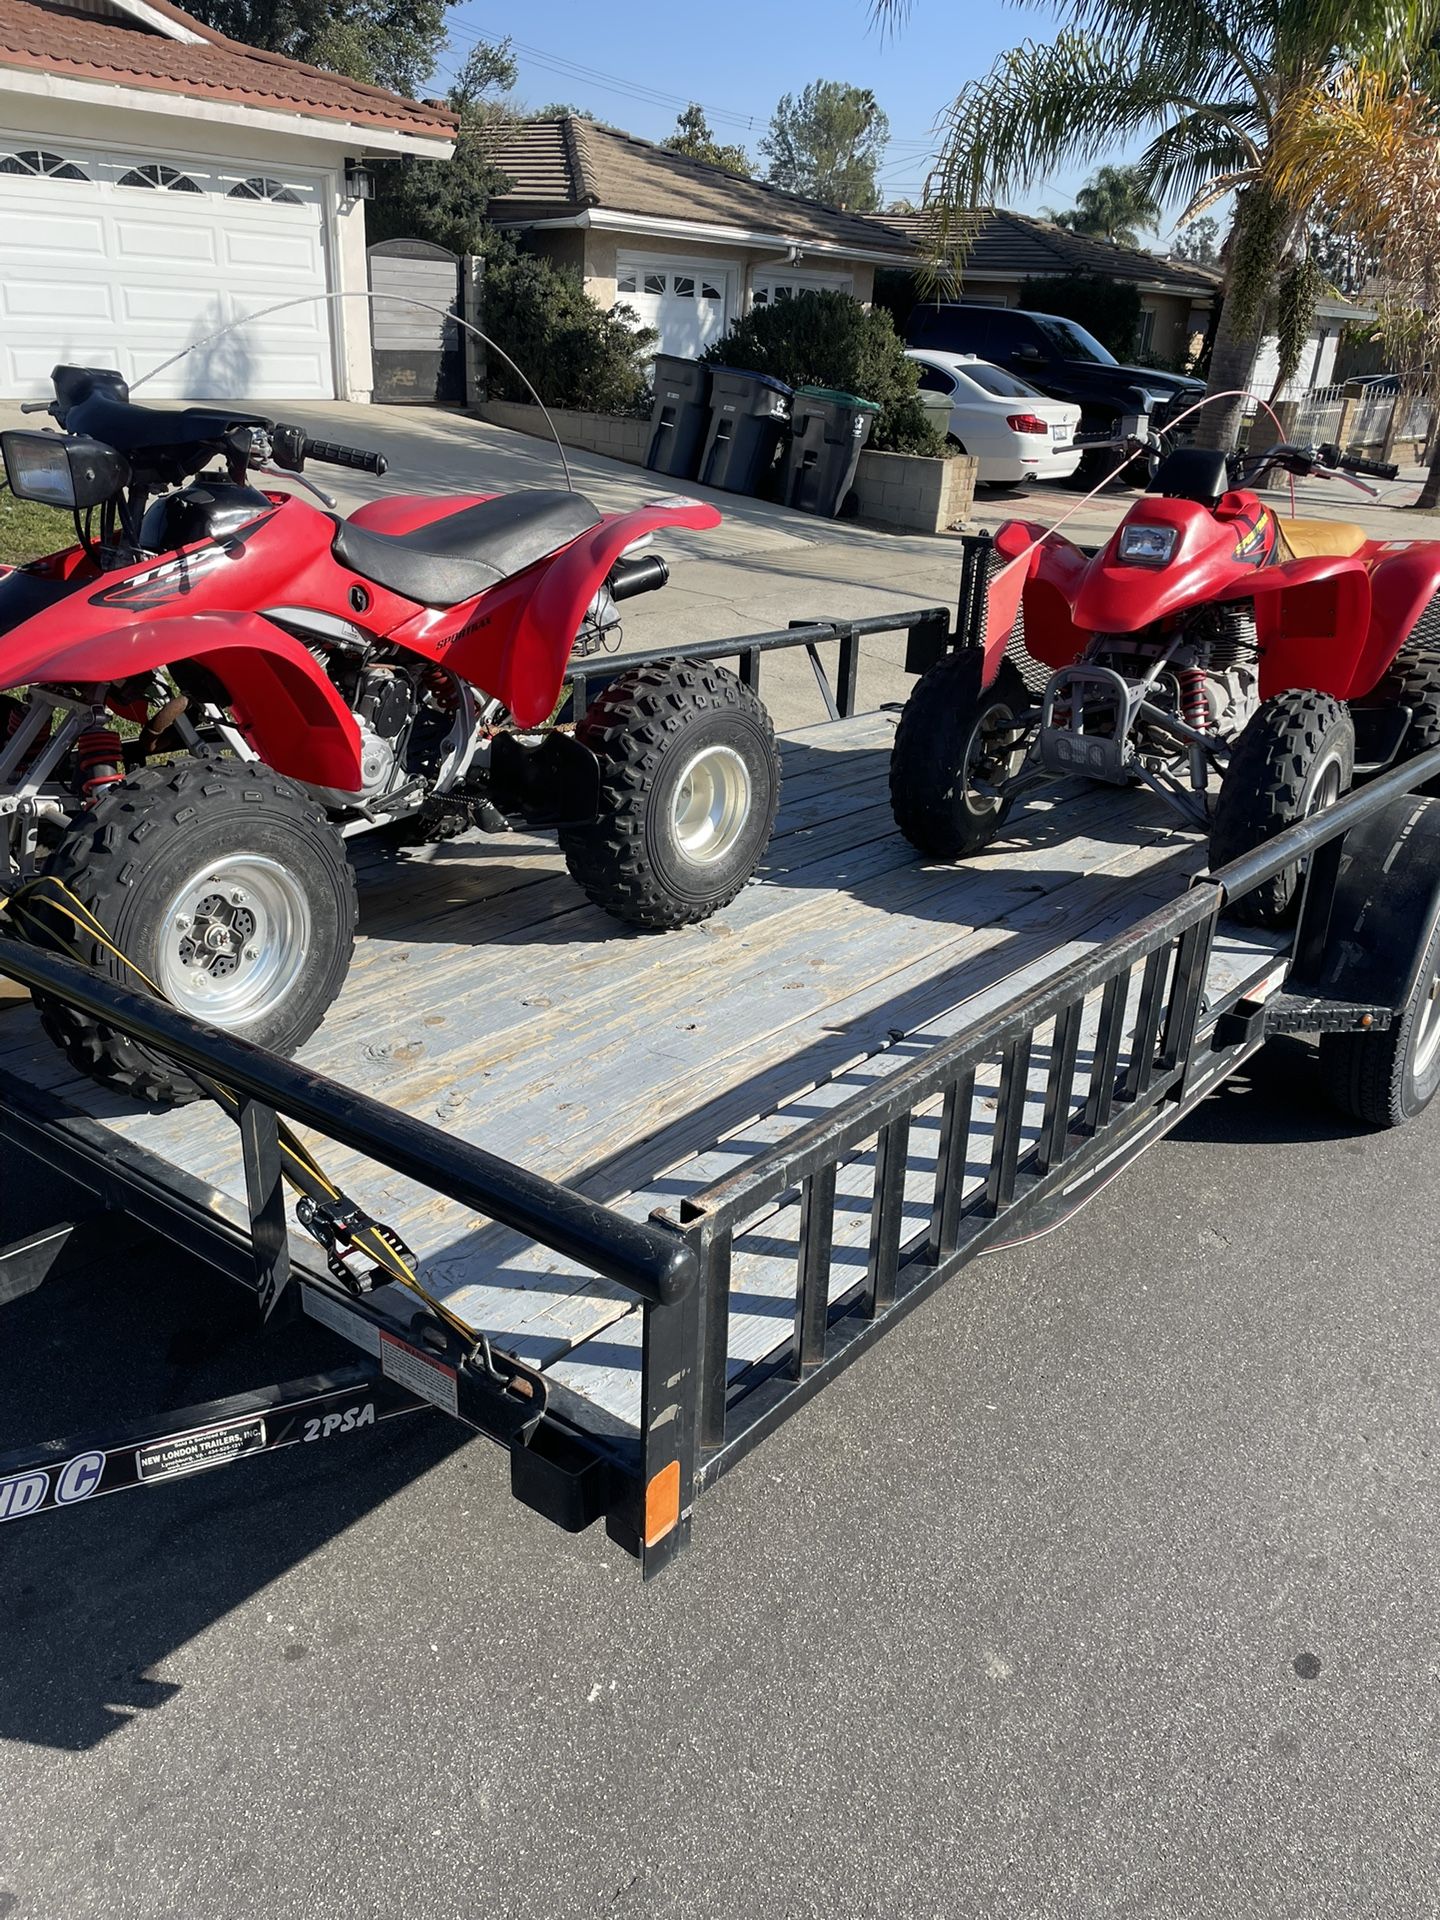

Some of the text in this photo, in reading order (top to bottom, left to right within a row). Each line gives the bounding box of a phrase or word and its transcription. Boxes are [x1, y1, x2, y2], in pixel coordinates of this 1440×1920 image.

[435, 616, 491, 650] SPORTRAX
[303, 1403, 375, 1442] 2PSA
[141, 1429, 261, 1467] NEW LONDON TRAILERS, INC.
[58, 1453, 103, 1502] C
